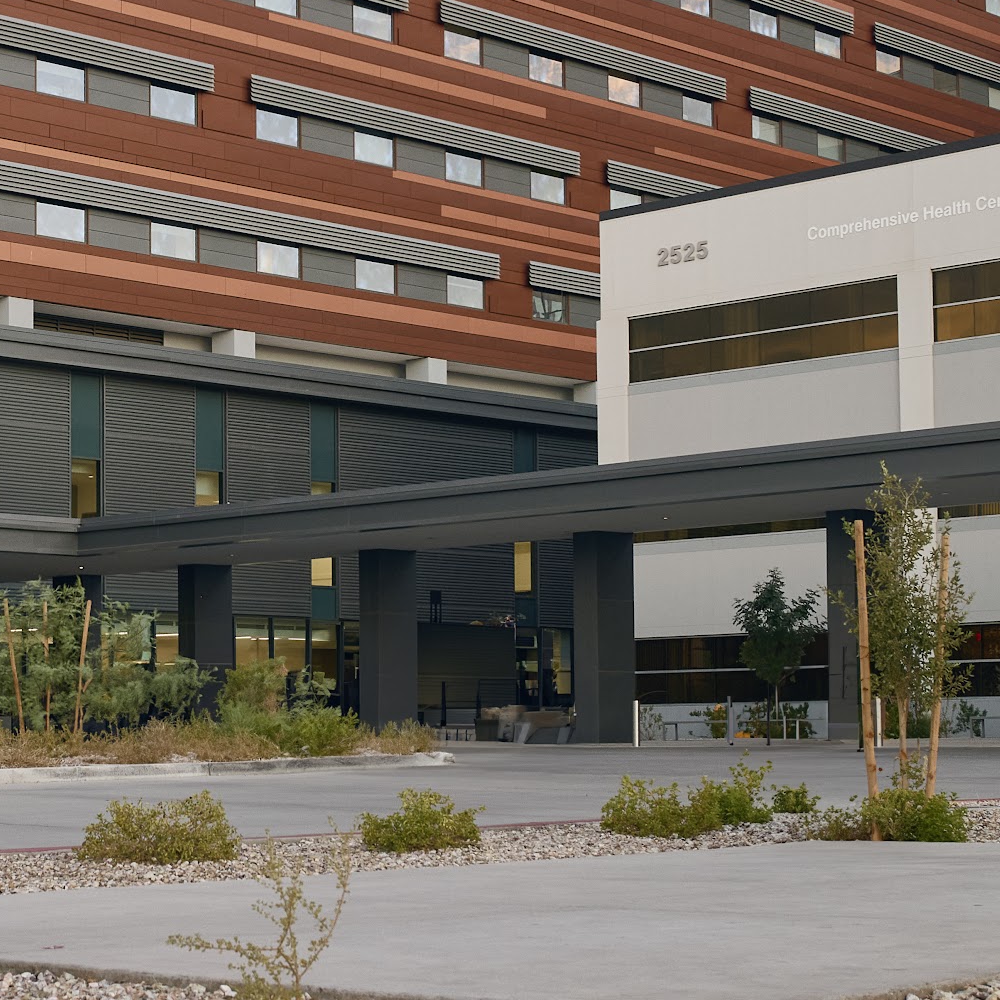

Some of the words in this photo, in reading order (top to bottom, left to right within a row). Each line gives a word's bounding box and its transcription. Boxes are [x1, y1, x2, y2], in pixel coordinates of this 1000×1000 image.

[807, 211, 919, 240] Comprehensive
[923, 199, 971, 220] Health
[657, 240, 709, 267] 2525
